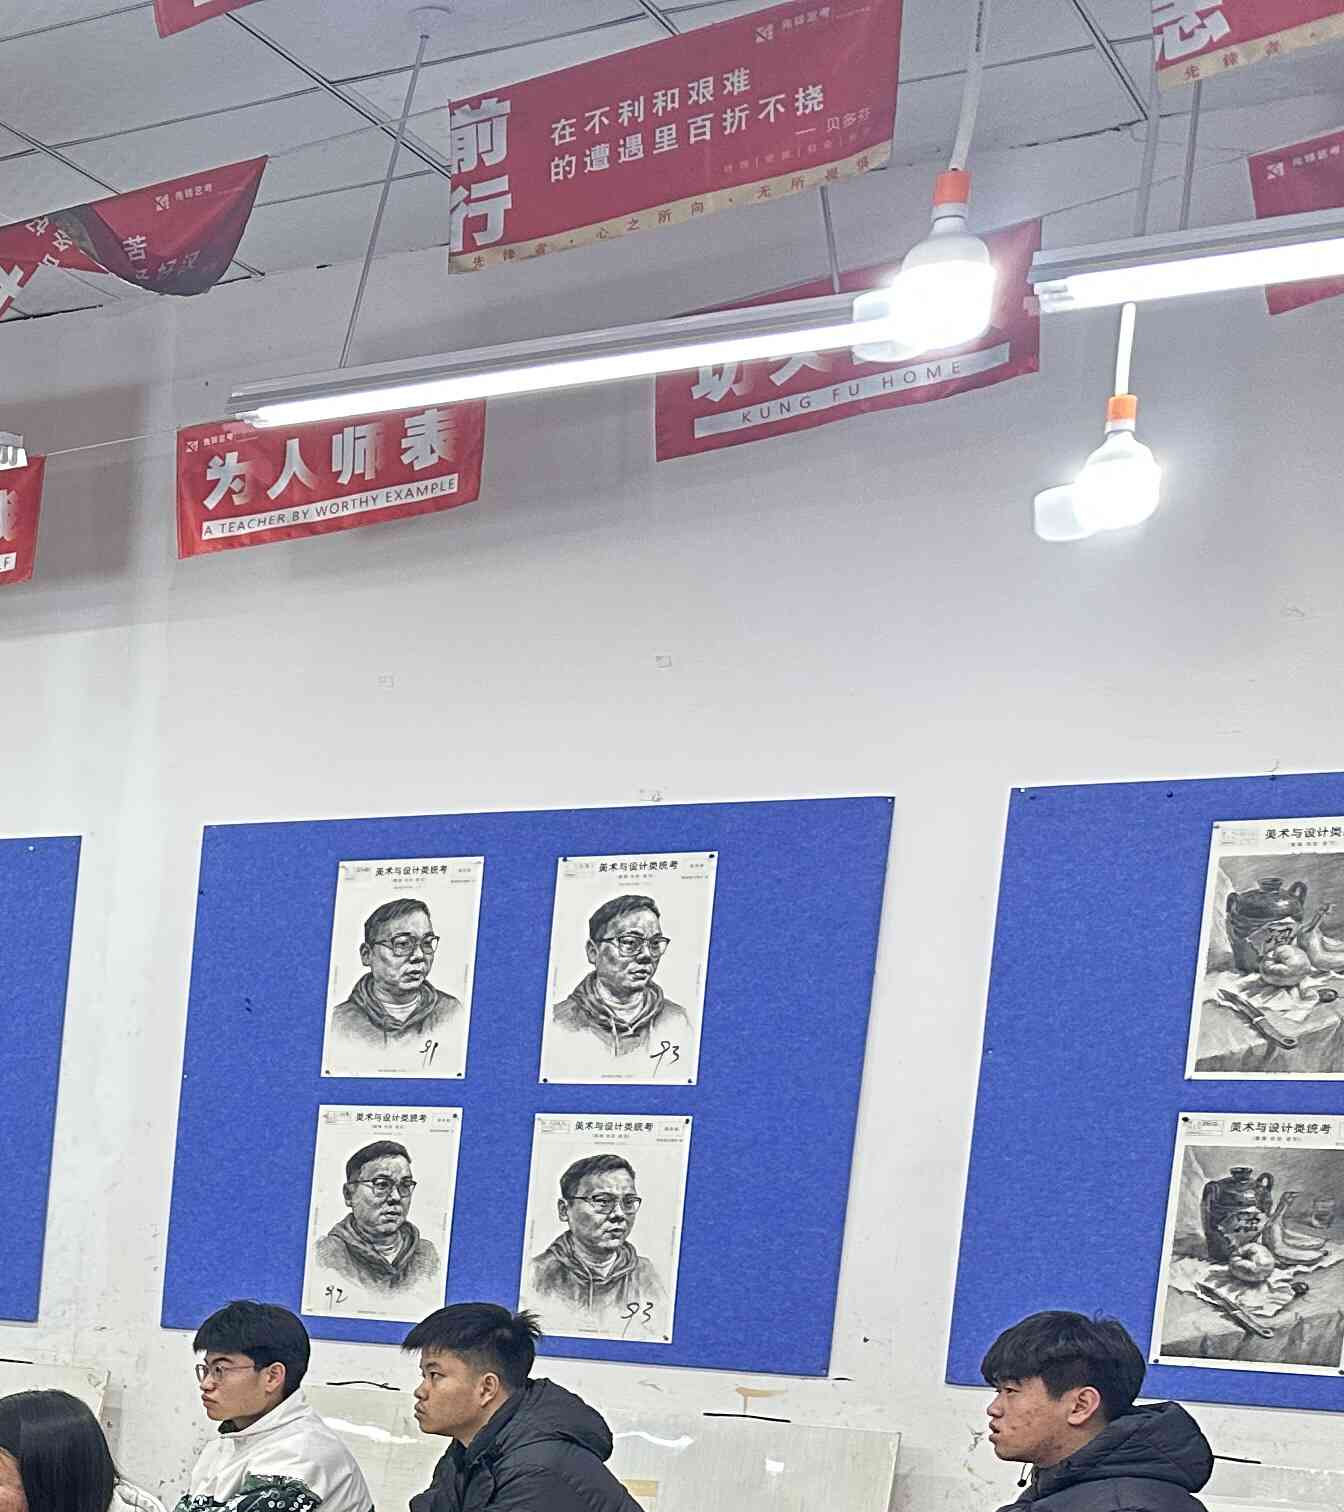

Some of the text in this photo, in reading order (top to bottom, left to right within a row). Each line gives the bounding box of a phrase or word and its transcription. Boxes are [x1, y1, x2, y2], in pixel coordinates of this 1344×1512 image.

[548, 84, 825, 184] 的遭遇里百折不挠
[549, 67, 752, 148] 在不利和艰难
[740, 360, 962, 424] KUNG FU HOME
[202, 406, 458, 512] 为人师表
[204, 478, 456, 537] A TEACHER BY WORTHY EXAMPLE
[1265, 826, 1344, 840] 美术与设计类
